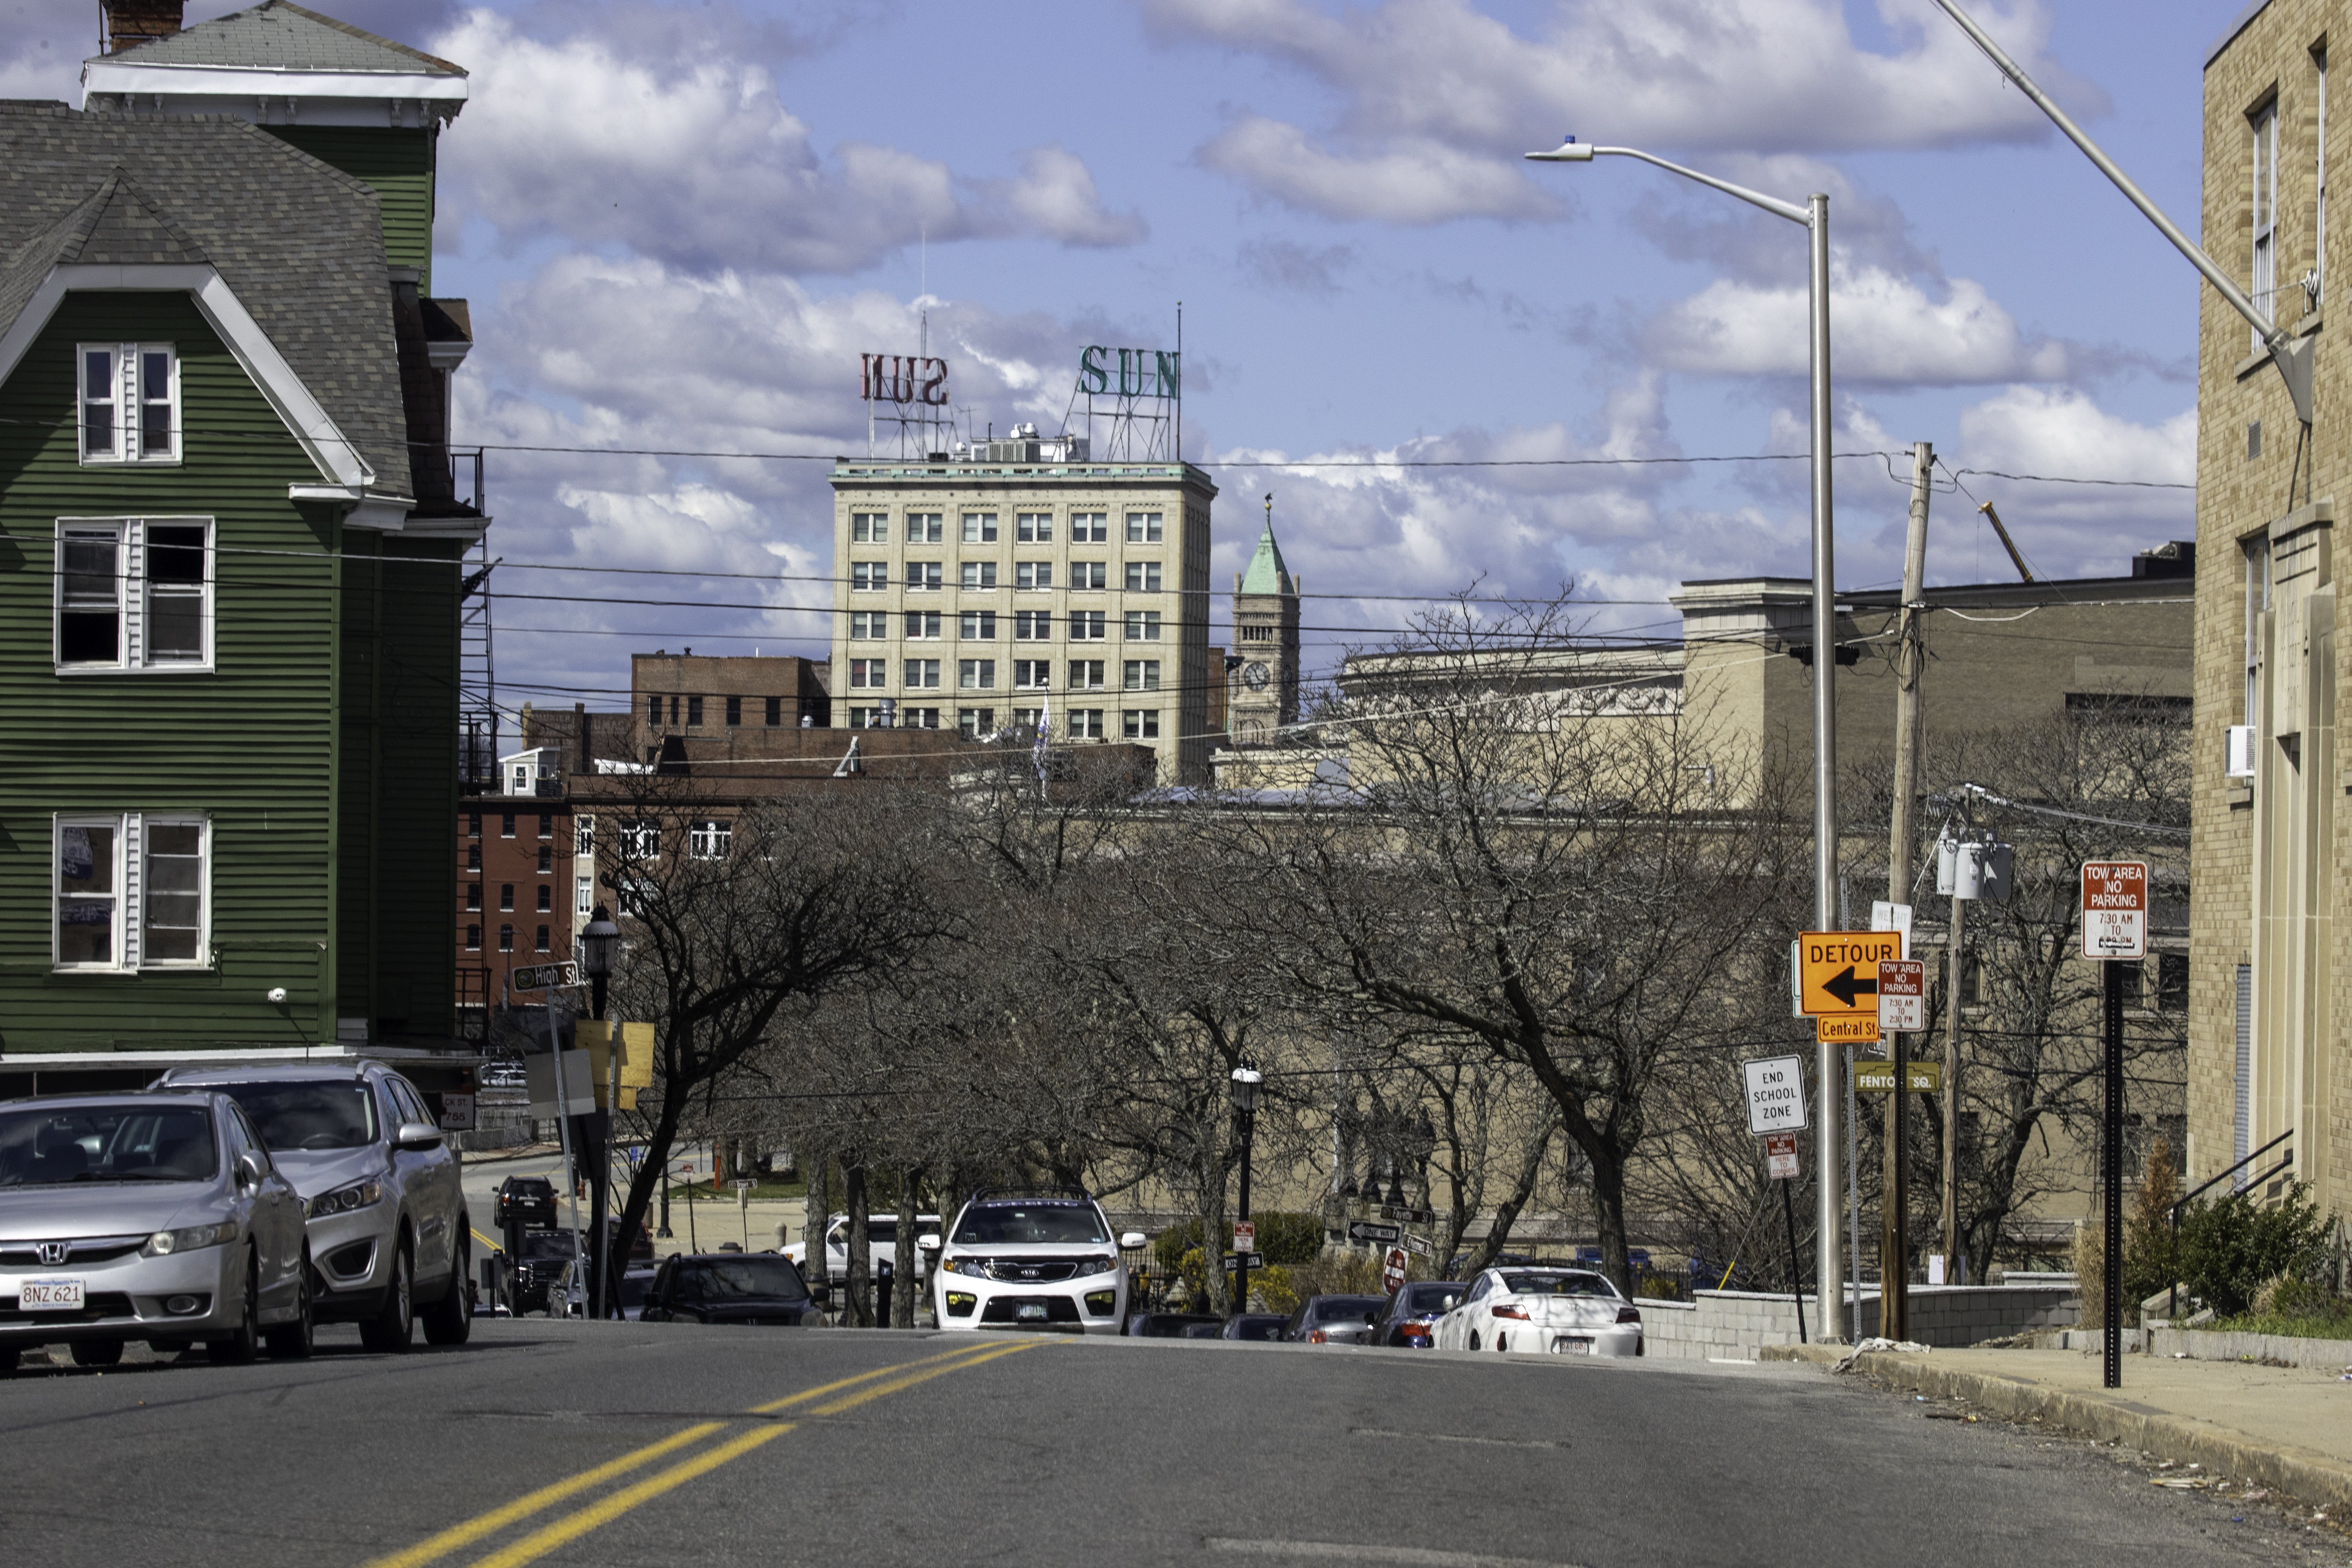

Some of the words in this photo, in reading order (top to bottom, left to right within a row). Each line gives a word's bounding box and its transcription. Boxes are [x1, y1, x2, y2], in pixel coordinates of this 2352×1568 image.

[1079, 345, 1179, 400] SUN
[2086, 866, 2110, 880] TOW
[2113, 866, 2143, 880] AREA
[2106, 880, 2122, 893] NO
[2091, 894, 2137, 907] PARKING
[2121, 913, 2133, 925] AM
[2111, 925, 2121, 936] TO
[1810, 944, 1893, 963] DETOUR
[1881, 963, 1898, 974] TOW
[1900, 963, 1921, 974] AREA
[535, 966, 559, 987] High
[566, 966, 576, 984] St
[1895, 973, 1907, 983] NO
[1884, 983, 1917, 994] PARKING
[1889, 998, 1902, 1007] 7:30
[1905, 999, 1913, 1007] AM
[1889, 1015, 1902, 1024] 2:30
[1904, 1016, 1913, 1024] PM
[1822, 1020, 1862, 1036] Central
[1866, 1021, 1876, 1035] St
[1762, 1071, 1783, 1084] END
[1859, 1075, 1896, 1088] FENTO
[1913, 1076, 1932, 1088] SQ.
[1753, 1087, 1797, 1103] SCHOOL
[457, 1098, 468, 1106] ST.
[1763, 1105, 1792, 1119] ZONE
[1767, 1135, 1778, 1143] TOW
[1780, 1133, 1793, 1142] AREA
[1771, 1146, 1792, 1155] PARKING
[1772, 1167, 1795, 1175] CORNER
[1392, 1208, 1413, 1221] Fayette
[1421, 1213, 1428, 1224] St
[1364, 1227, 1378, 1236] ONE
[1379, 1228, 1394, 1238] WAY
[1228, 1259, 1237, 1267] ON
[1248, 1256, 1258, 1265] AY
[24, 1287, 50, 1303] 8NZ
[54, 1286, 80, 1302] 621
